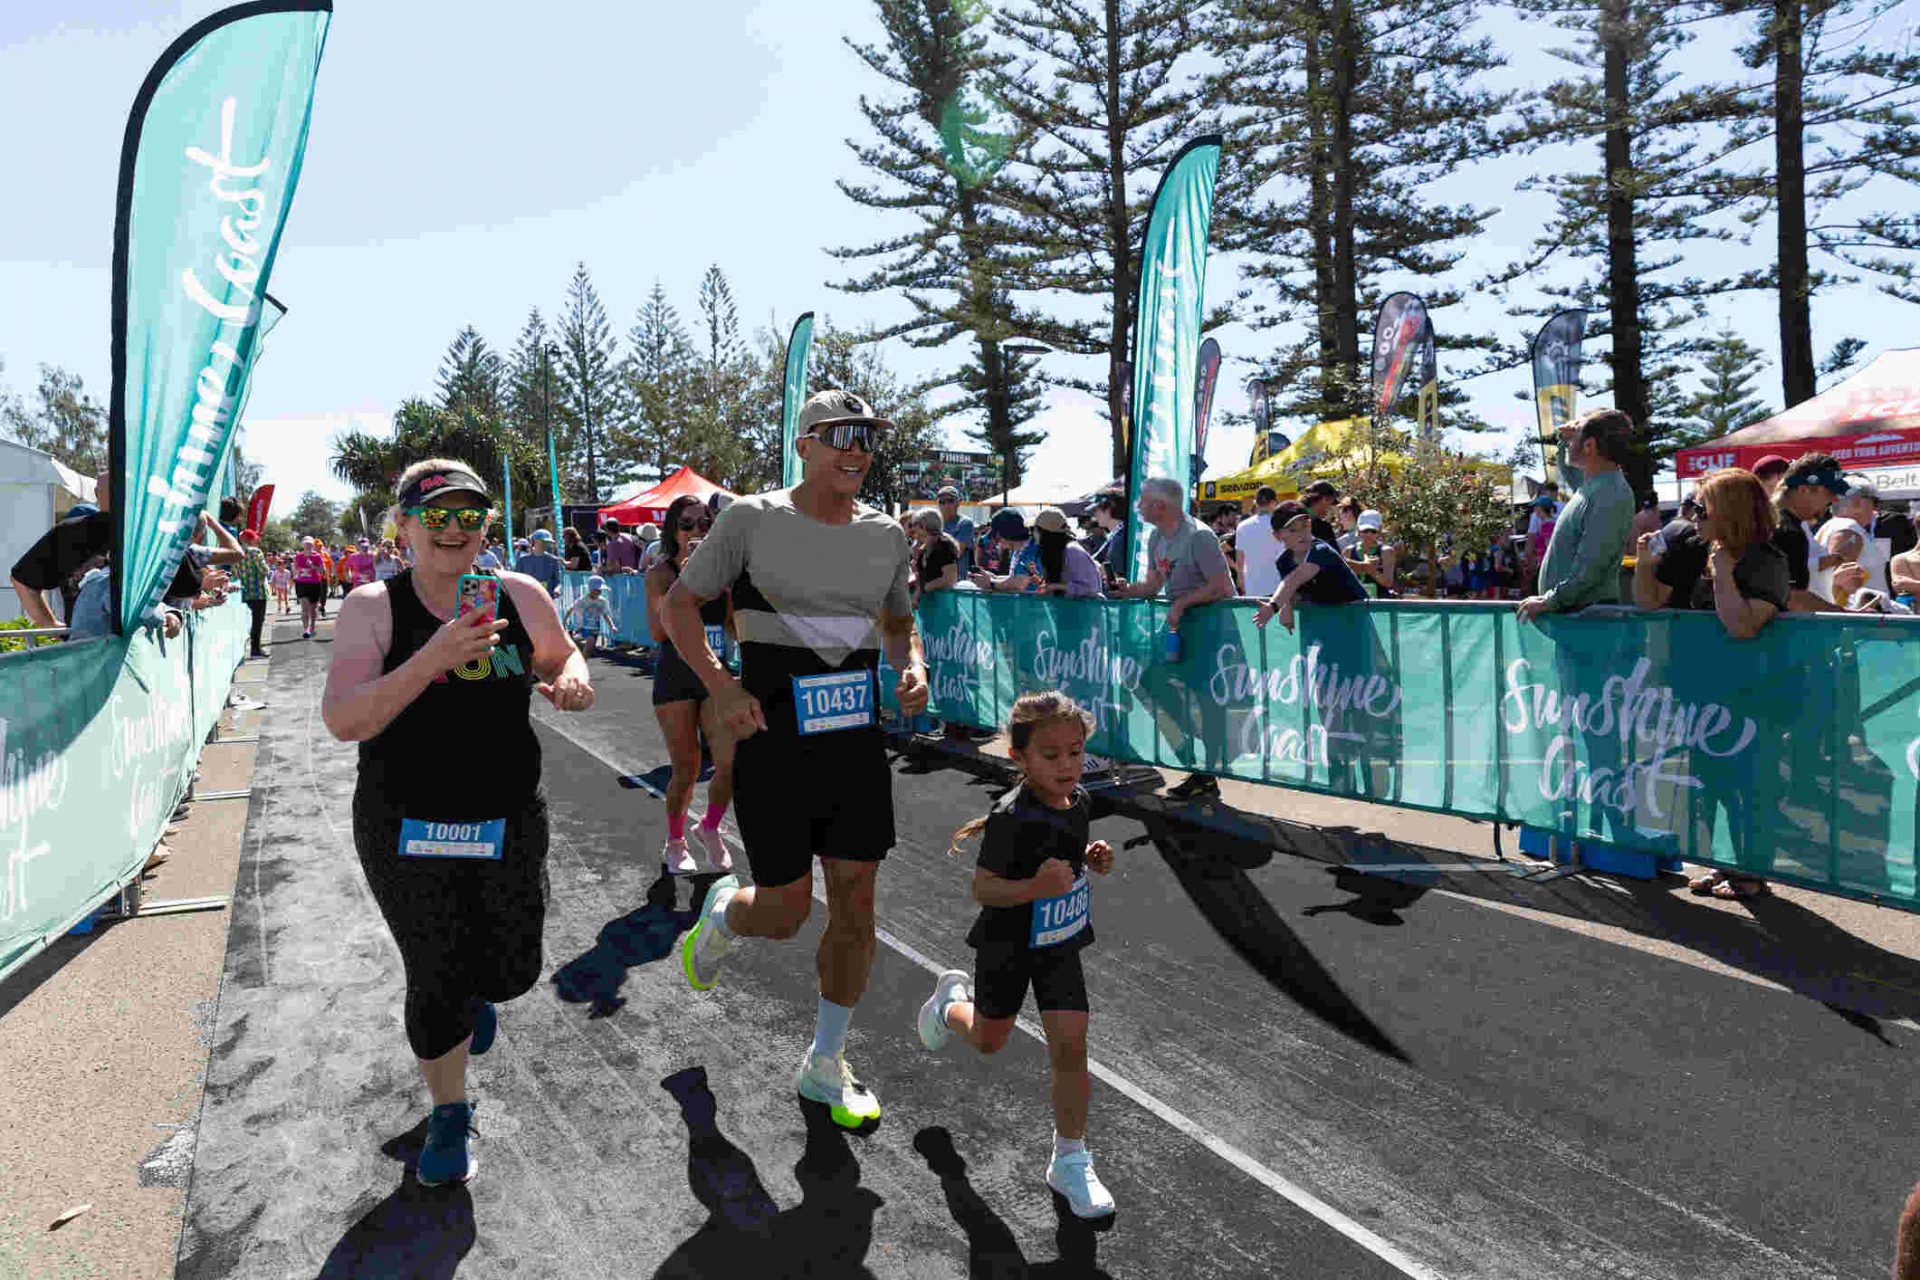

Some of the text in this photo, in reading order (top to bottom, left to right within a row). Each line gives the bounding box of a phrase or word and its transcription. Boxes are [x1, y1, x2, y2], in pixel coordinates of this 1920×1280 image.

[1696, 453, 1736, 472] CLIF
[434, 644, 525, 684] UN
[802, 685, 867, 715] 10437
[1500, 657, 1757, 757] Sunshine
[425, 822, 481, 841] 10001
